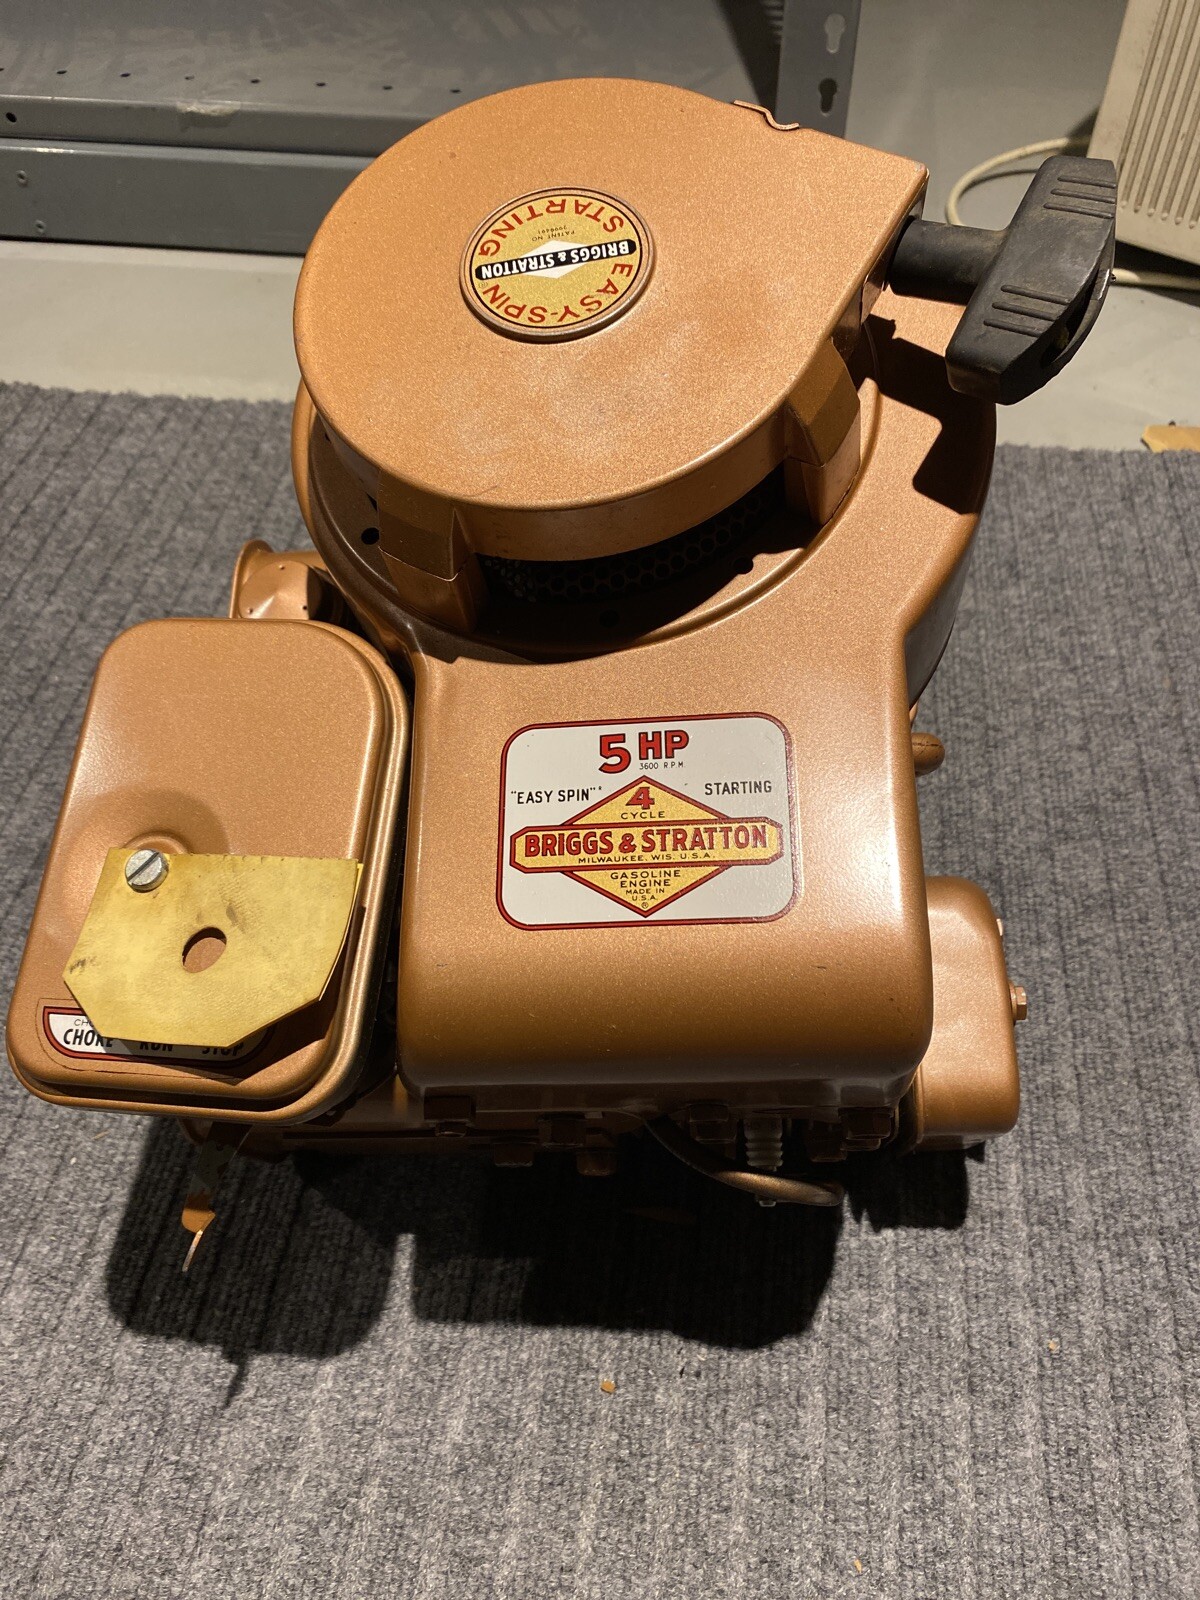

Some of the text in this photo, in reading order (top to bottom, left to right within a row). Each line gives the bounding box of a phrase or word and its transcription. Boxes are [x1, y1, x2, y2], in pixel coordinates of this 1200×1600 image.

[478, 199, 625, 257] STARTING
[547, 230, 575, 239] PATENT
[481, 240, 630, 279] BRIGGS & STRATTON
[598, 729, 690, 774] 5 HP
[639, 762, 659, 770] 3600
[704, 780, 773, 796] STARTING
[625, 786, 655, 810] 4
[620, 810, 666, 820] CYCLE
[524, 825, 768, 858] BRIGGS & STRATTON
[610, 869, 681, 880] GASOLINE
[620, 879, 671, 888] ENGINE
